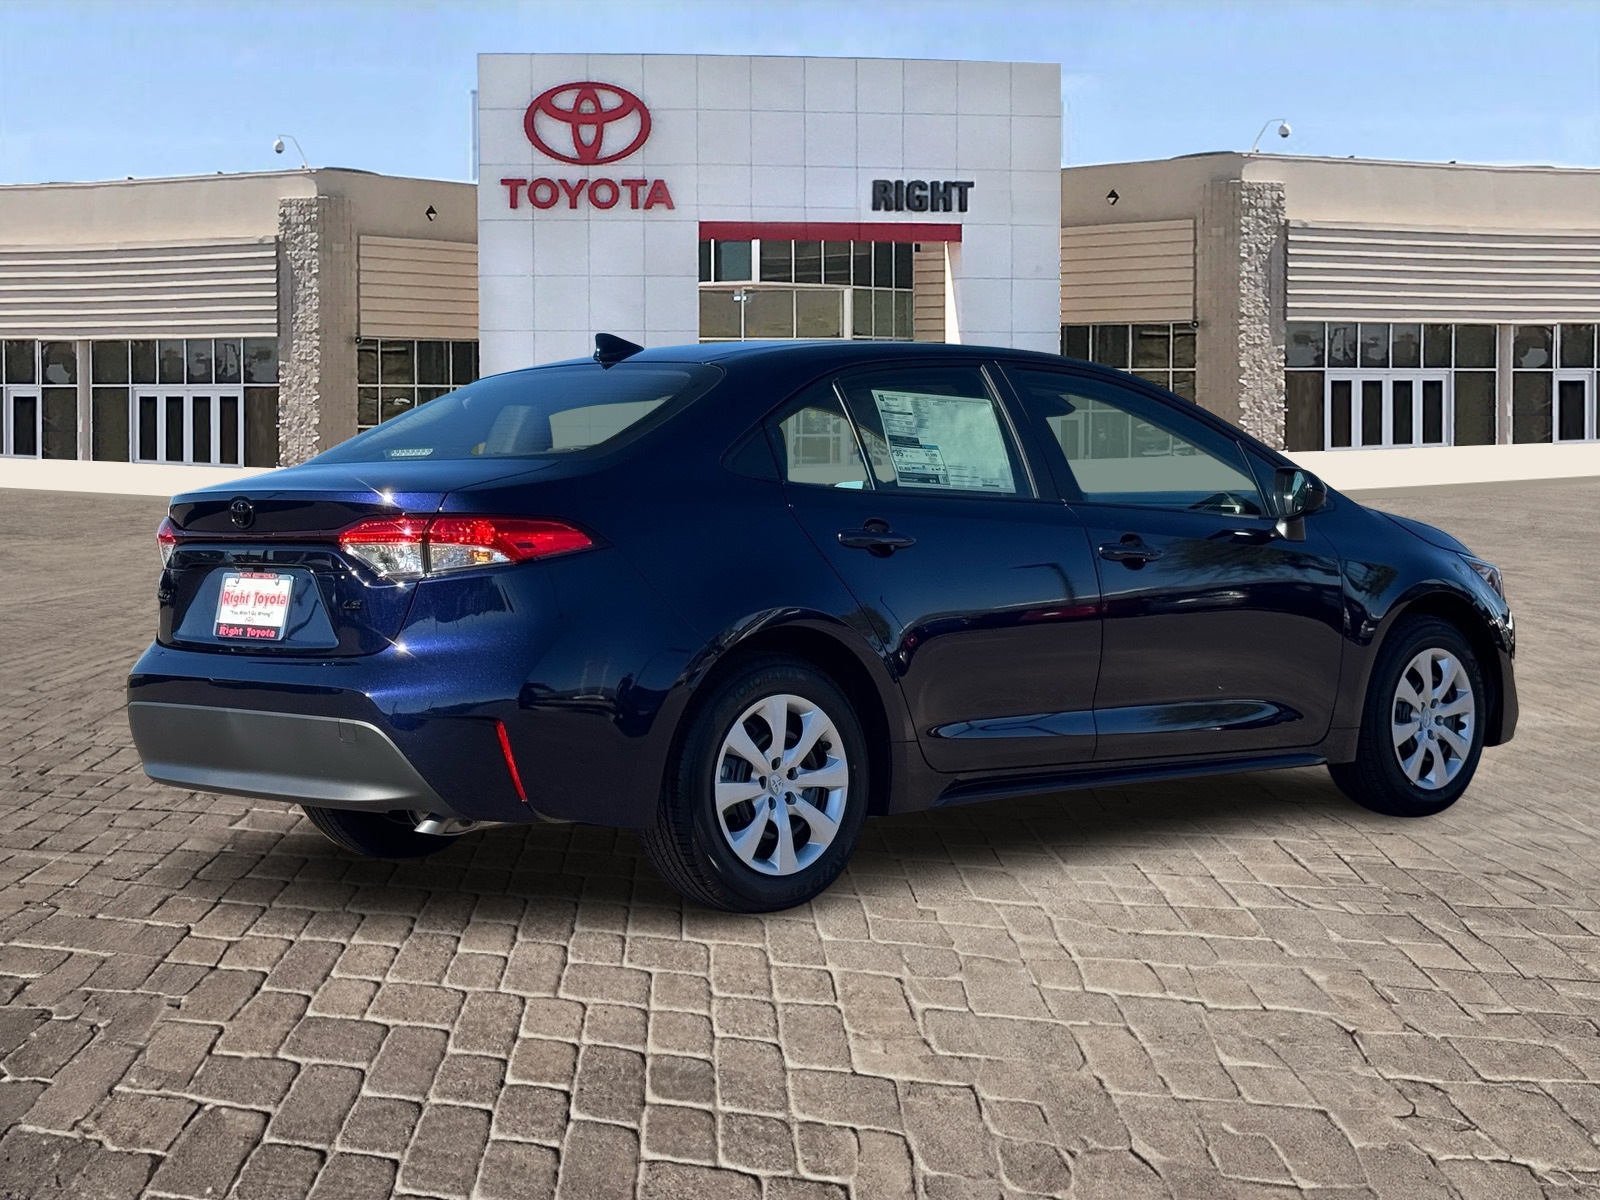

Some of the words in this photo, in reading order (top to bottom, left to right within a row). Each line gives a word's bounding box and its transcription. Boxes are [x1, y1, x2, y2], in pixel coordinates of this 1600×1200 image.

[500, 178, 675, 210] TOYOTA
[871, 180, 975, 213] RIGHT
[222, 591, 250, 607] Right
[253, 591, 287, 607] Toyota
[219, 626, 243, 637] Right
[246, 626, 276, 638] Toyota
